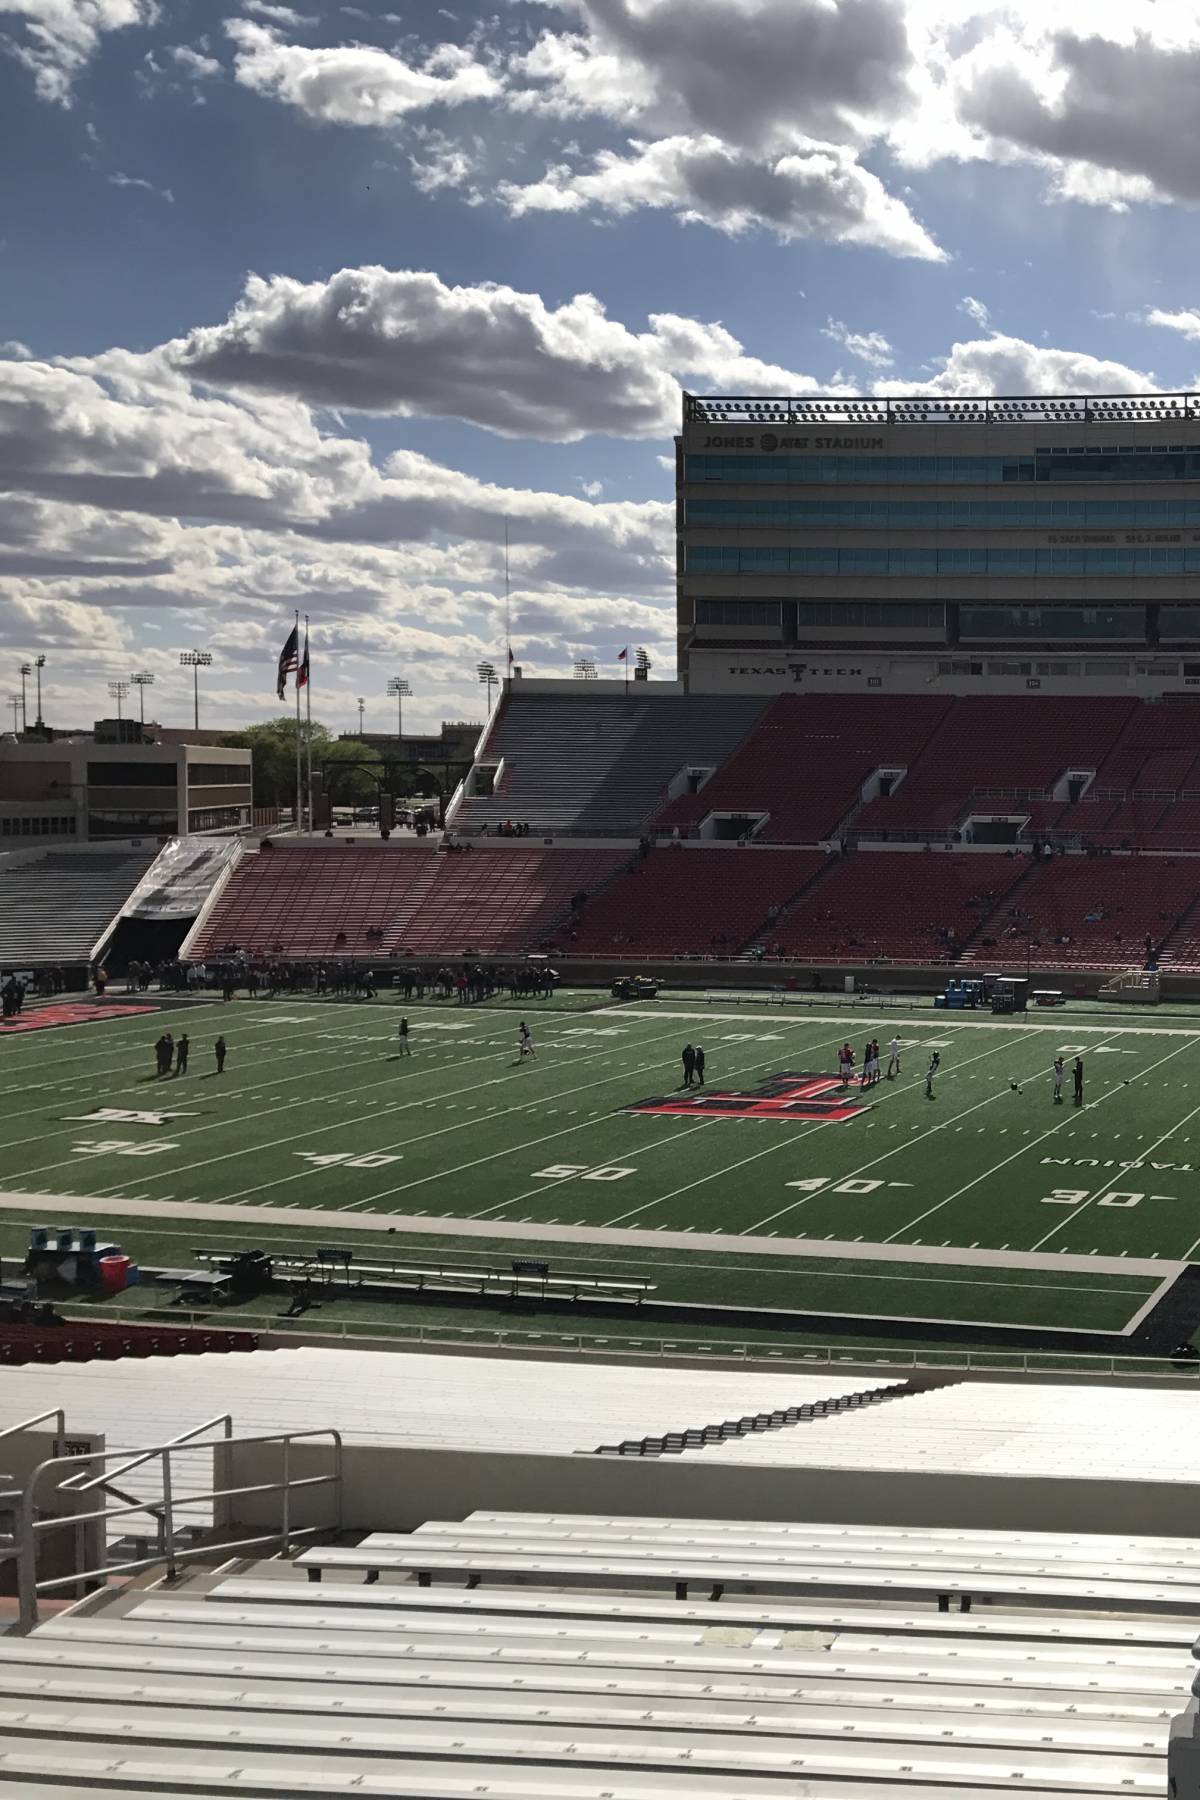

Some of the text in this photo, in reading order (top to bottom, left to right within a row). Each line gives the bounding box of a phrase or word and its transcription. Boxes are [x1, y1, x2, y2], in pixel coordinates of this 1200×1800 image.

[704, 436, 883, 449] JONES AT&T STADIUM
[728, 667, 786, 675] TEXAS
[809, 668, 862, 676] TECH
[70, 1140, 181, 1156] 30
[303, 1152, 404, 1167] 40
[530, 1164, 638, 1181] 50
[785, 1177, 885, 1194] 40
[1040, 1189, 1146, 1208] 30
